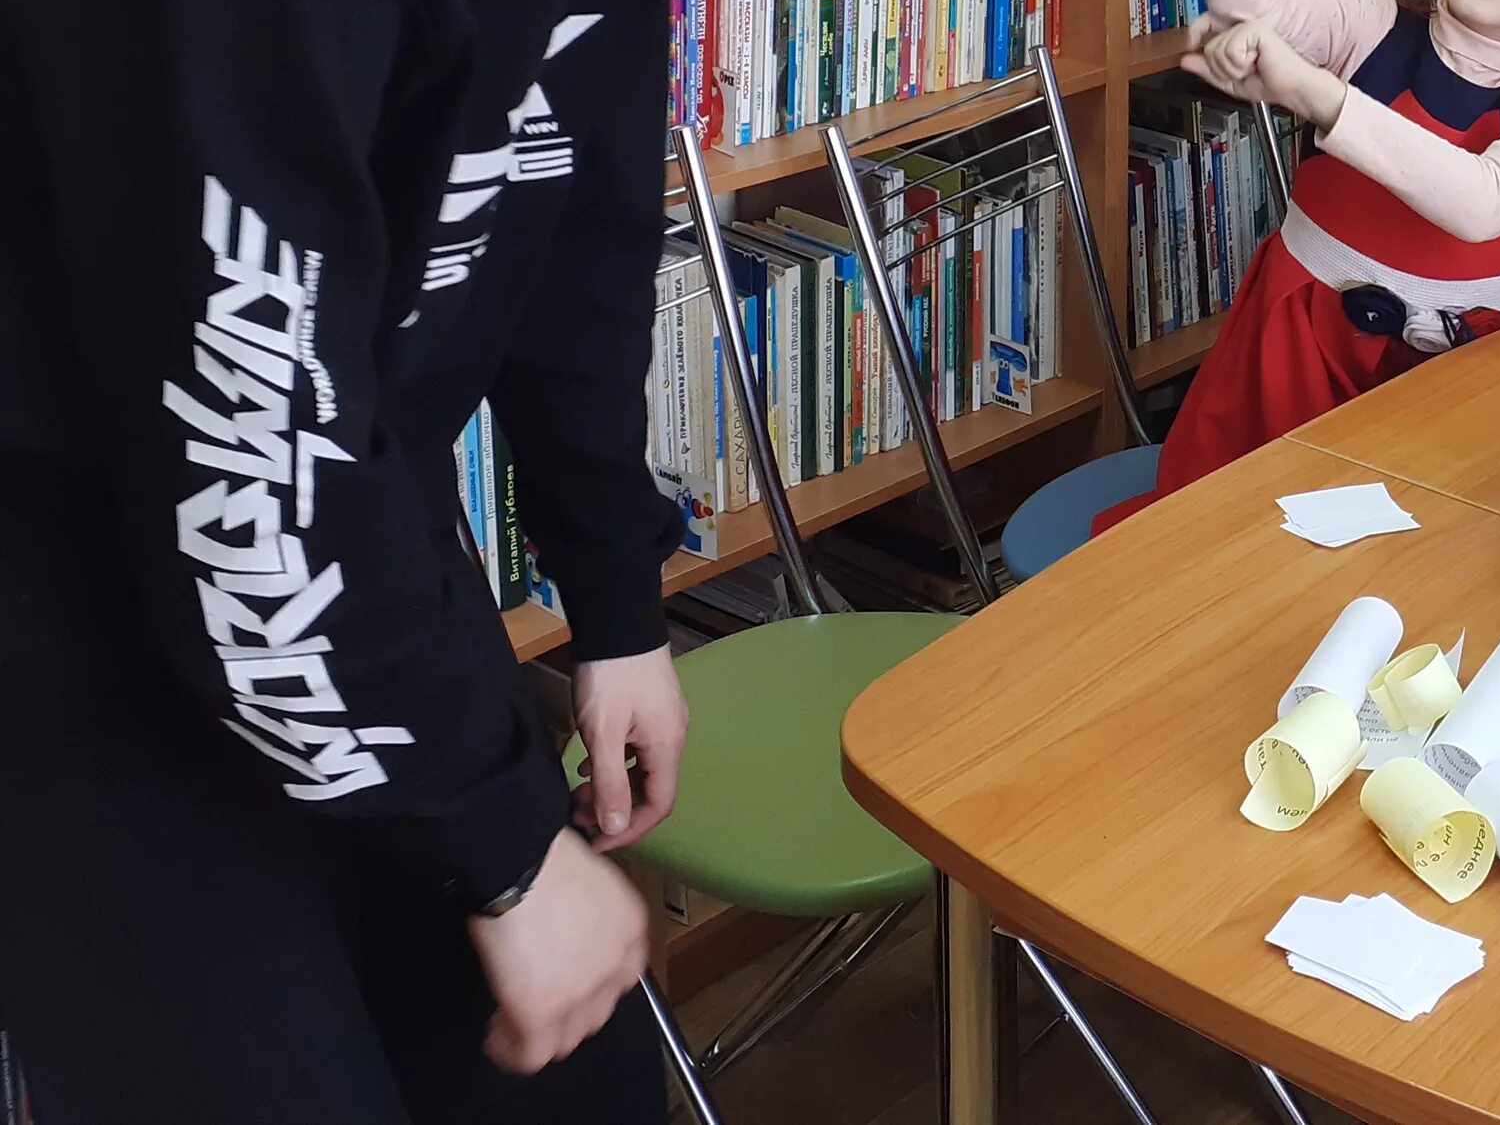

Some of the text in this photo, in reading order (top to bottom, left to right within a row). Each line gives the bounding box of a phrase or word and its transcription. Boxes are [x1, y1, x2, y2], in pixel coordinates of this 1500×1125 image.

[820, 21, 829, 56] Честное
[298, 310, 339, 423] WORLDWIDE
[677, 330, 687, 439] ПРИКЛЮЧЕНИЯ ЗЕЛЁНОГО
[790, 354, 799, 394] ЛЕСНОЙ
[824, 344, 833, 384] ЛЕСНОЙ
[507, 526, 520, 582] Виталий
